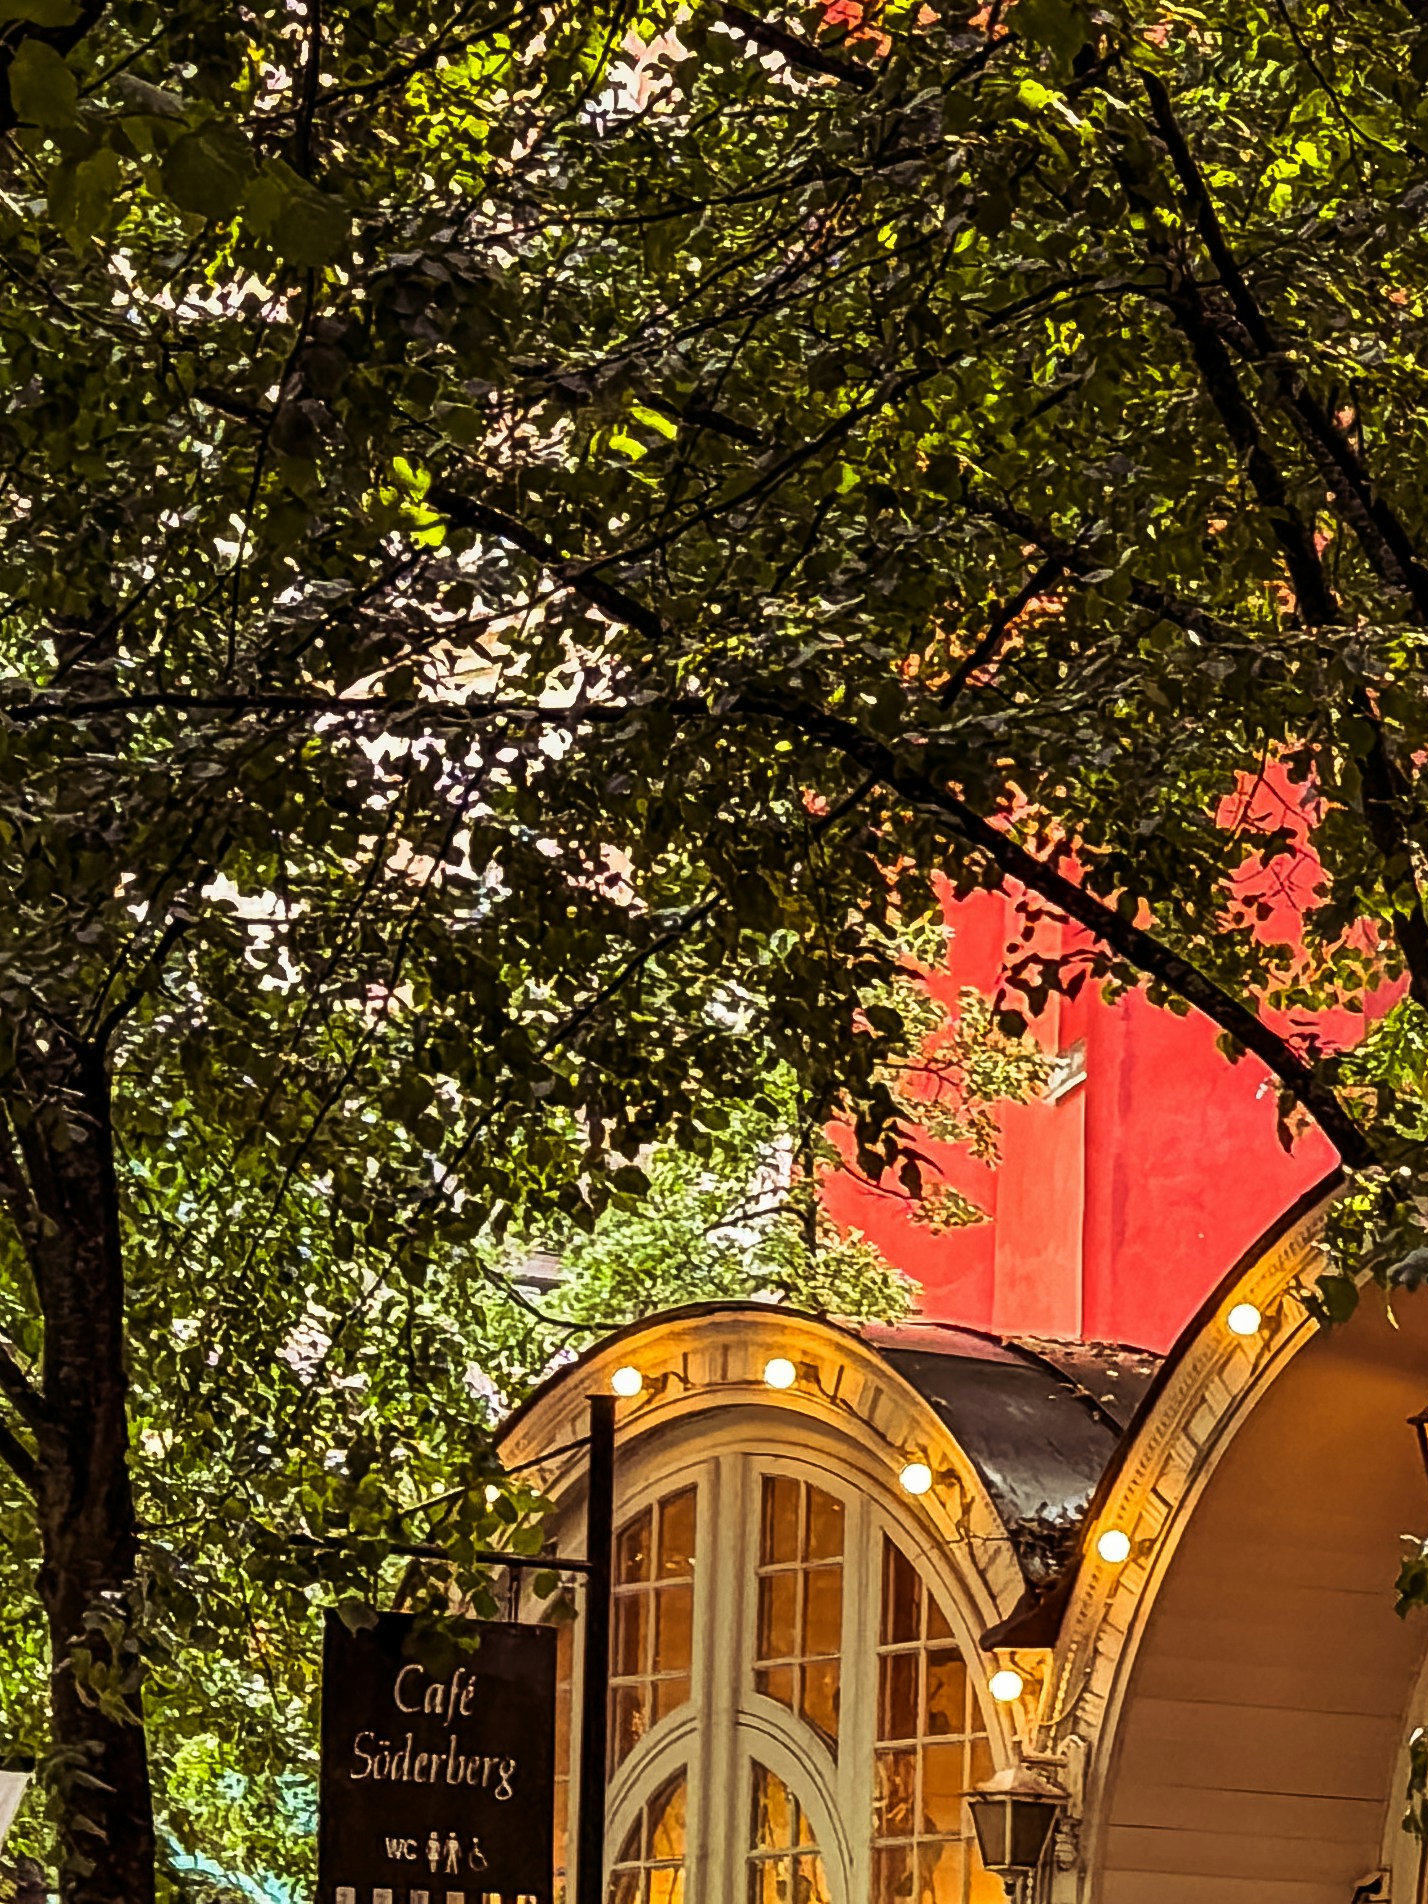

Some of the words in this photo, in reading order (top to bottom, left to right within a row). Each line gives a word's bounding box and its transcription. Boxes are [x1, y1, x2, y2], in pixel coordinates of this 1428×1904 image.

[393, 1663, 477, 1727] Café
[350, 1731, 516, 1801] Söderberg
[385, 1837, 418, 1860] WC
